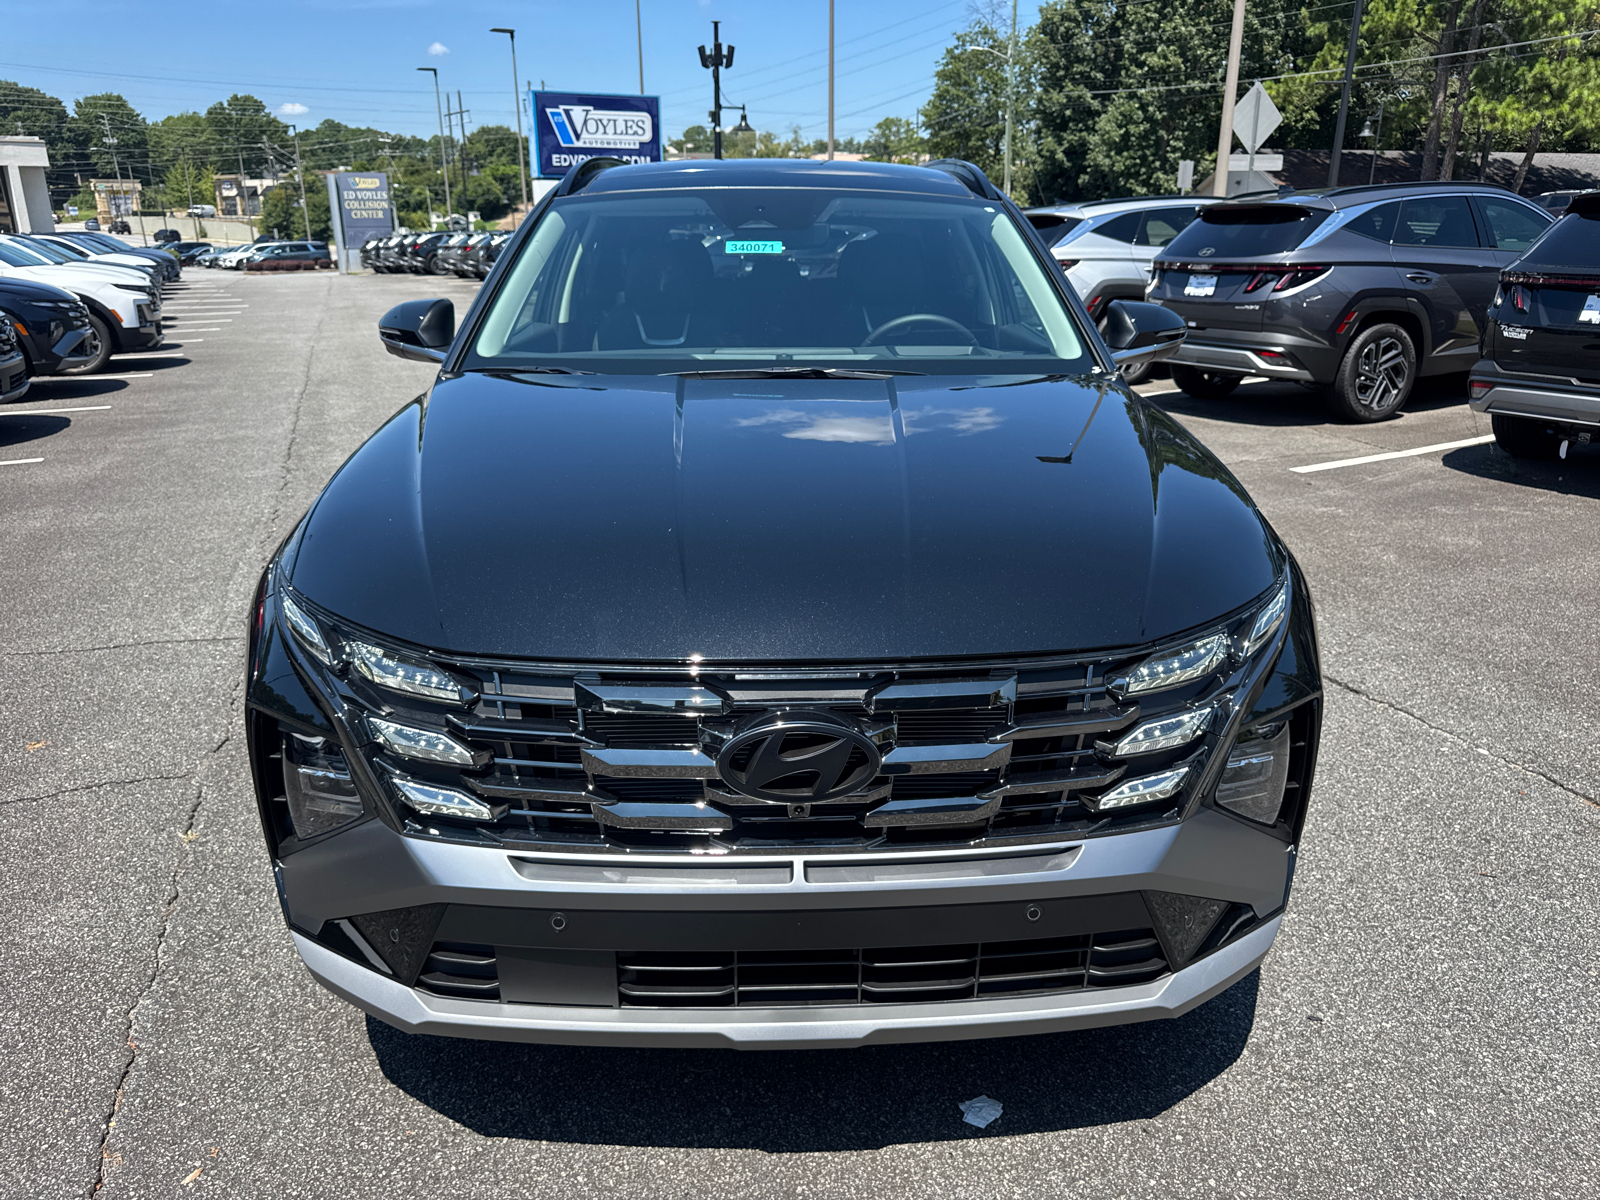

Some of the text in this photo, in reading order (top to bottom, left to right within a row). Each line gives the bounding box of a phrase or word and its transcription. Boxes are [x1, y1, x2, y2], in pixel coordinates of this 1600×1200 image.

[562, 108, 646, 142] VOYLES
[343, 190, 388, 200] ED VOYLES
[344, 200, 389, 210] COLLISION
[351, 210, 384, 219] CENTER
[730, 243, 775, 252] 340071
